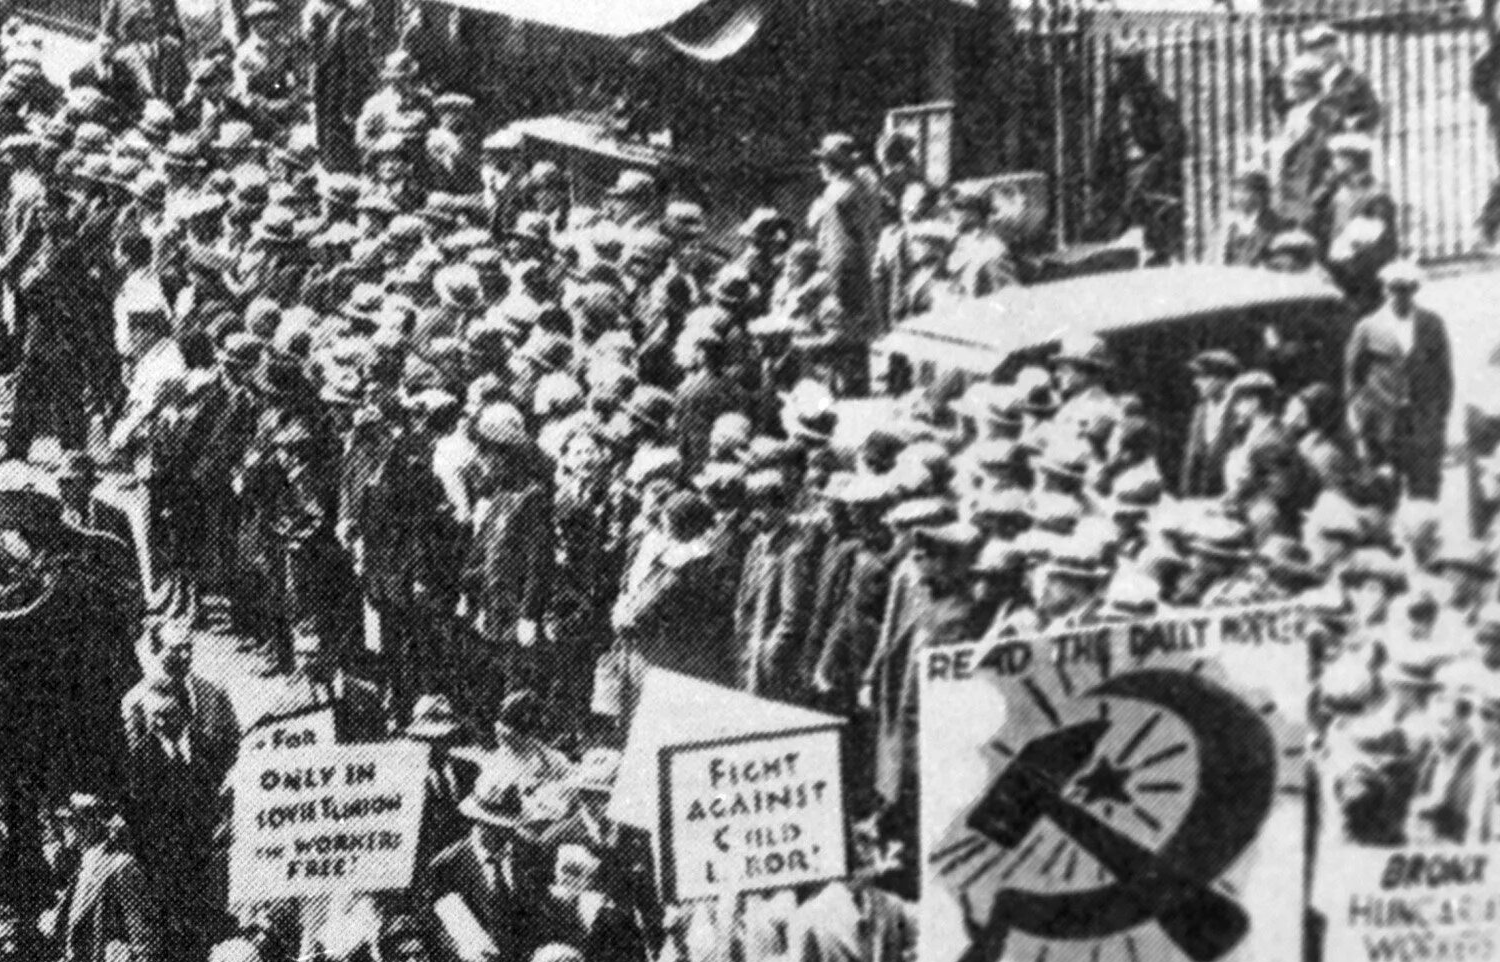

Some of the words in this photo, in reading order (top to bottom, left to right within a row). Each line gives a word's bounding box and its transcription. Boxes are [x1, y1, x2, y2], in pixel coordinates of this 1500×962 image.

[927, 641, 1032, 681] READ
[1129, 617, 1210, 657] DAILY
[260, 765, 336, 791] ONLY
[346, 762, 376, 786] IN
[710, 752, 799, 788] FIGHT
[256, 795, 334, 830] SOVIET
[332, 794, 402, 822] UNION
[686, 780, 827, 822] AGAINST
[294, 829, 402, 855] WORKERS
[706, 844, 820, 883] LBOR!
[1381, 852, 1488, 891] BRONX
